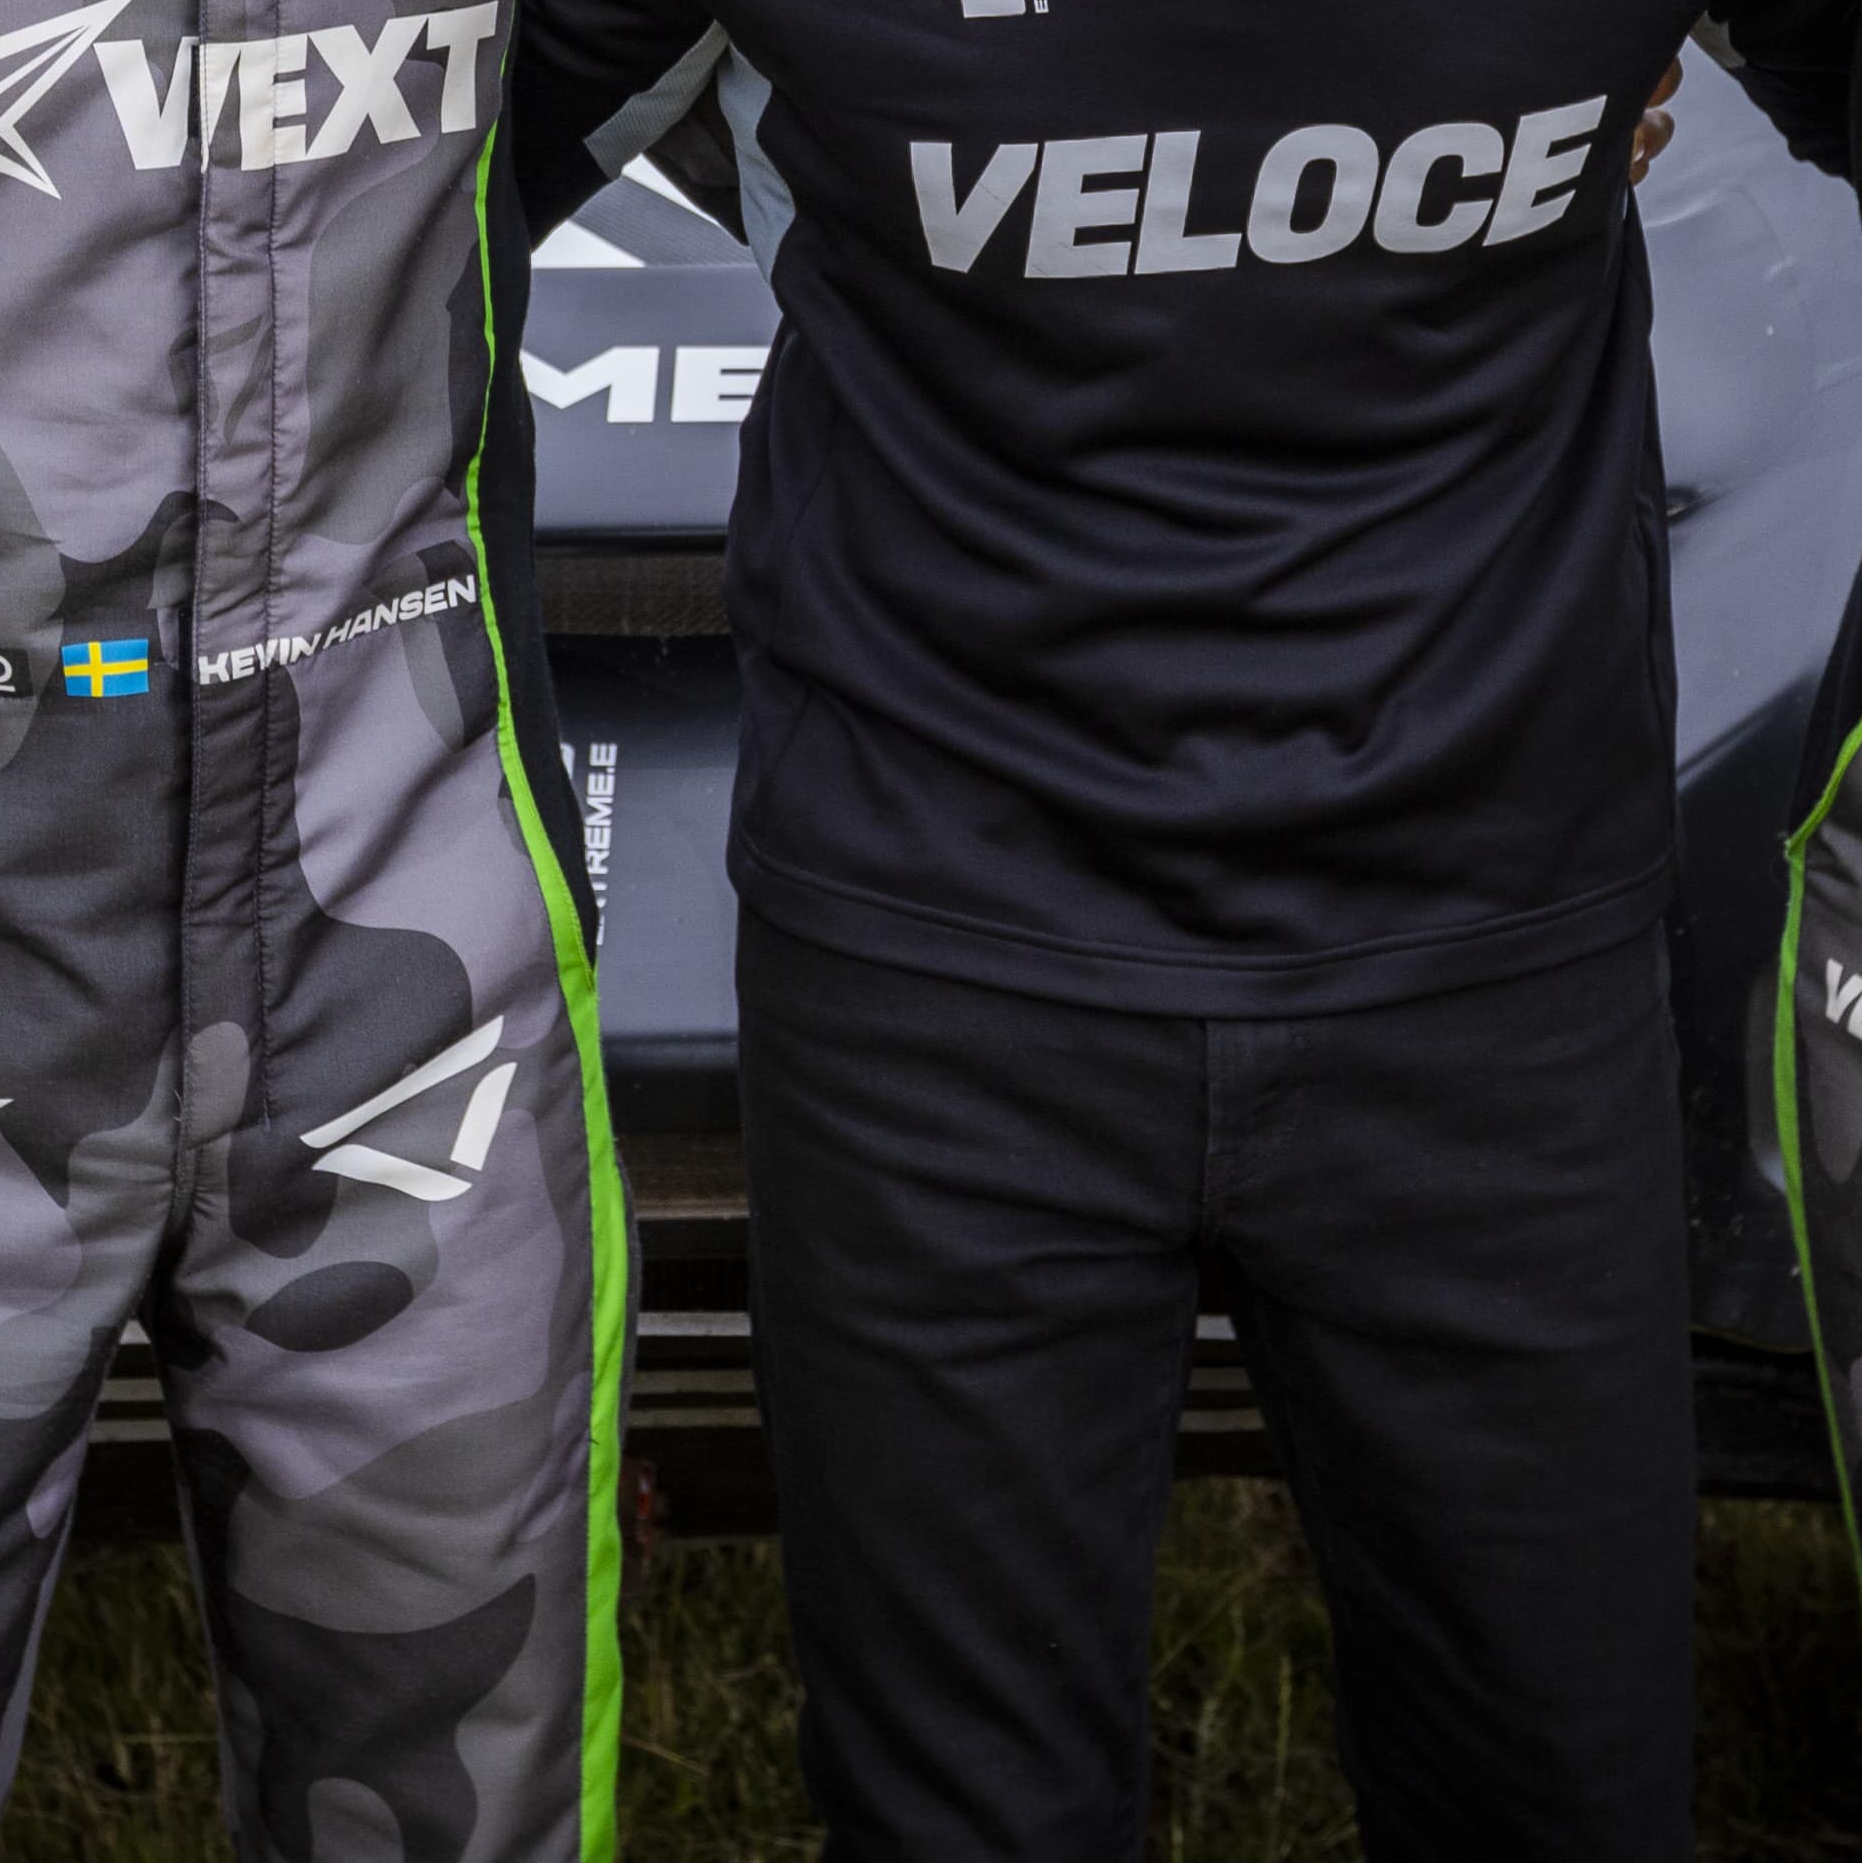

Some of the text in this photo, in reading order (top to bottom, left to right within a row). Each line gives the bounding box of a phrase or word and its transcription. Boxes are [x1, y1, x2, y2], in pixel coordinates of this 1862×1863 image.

[93, 0, 499, 173] VEXT
[909, 93, 1609, 278] VELOCE
[197, 574, 477, 685] KEVIN HANSEN
